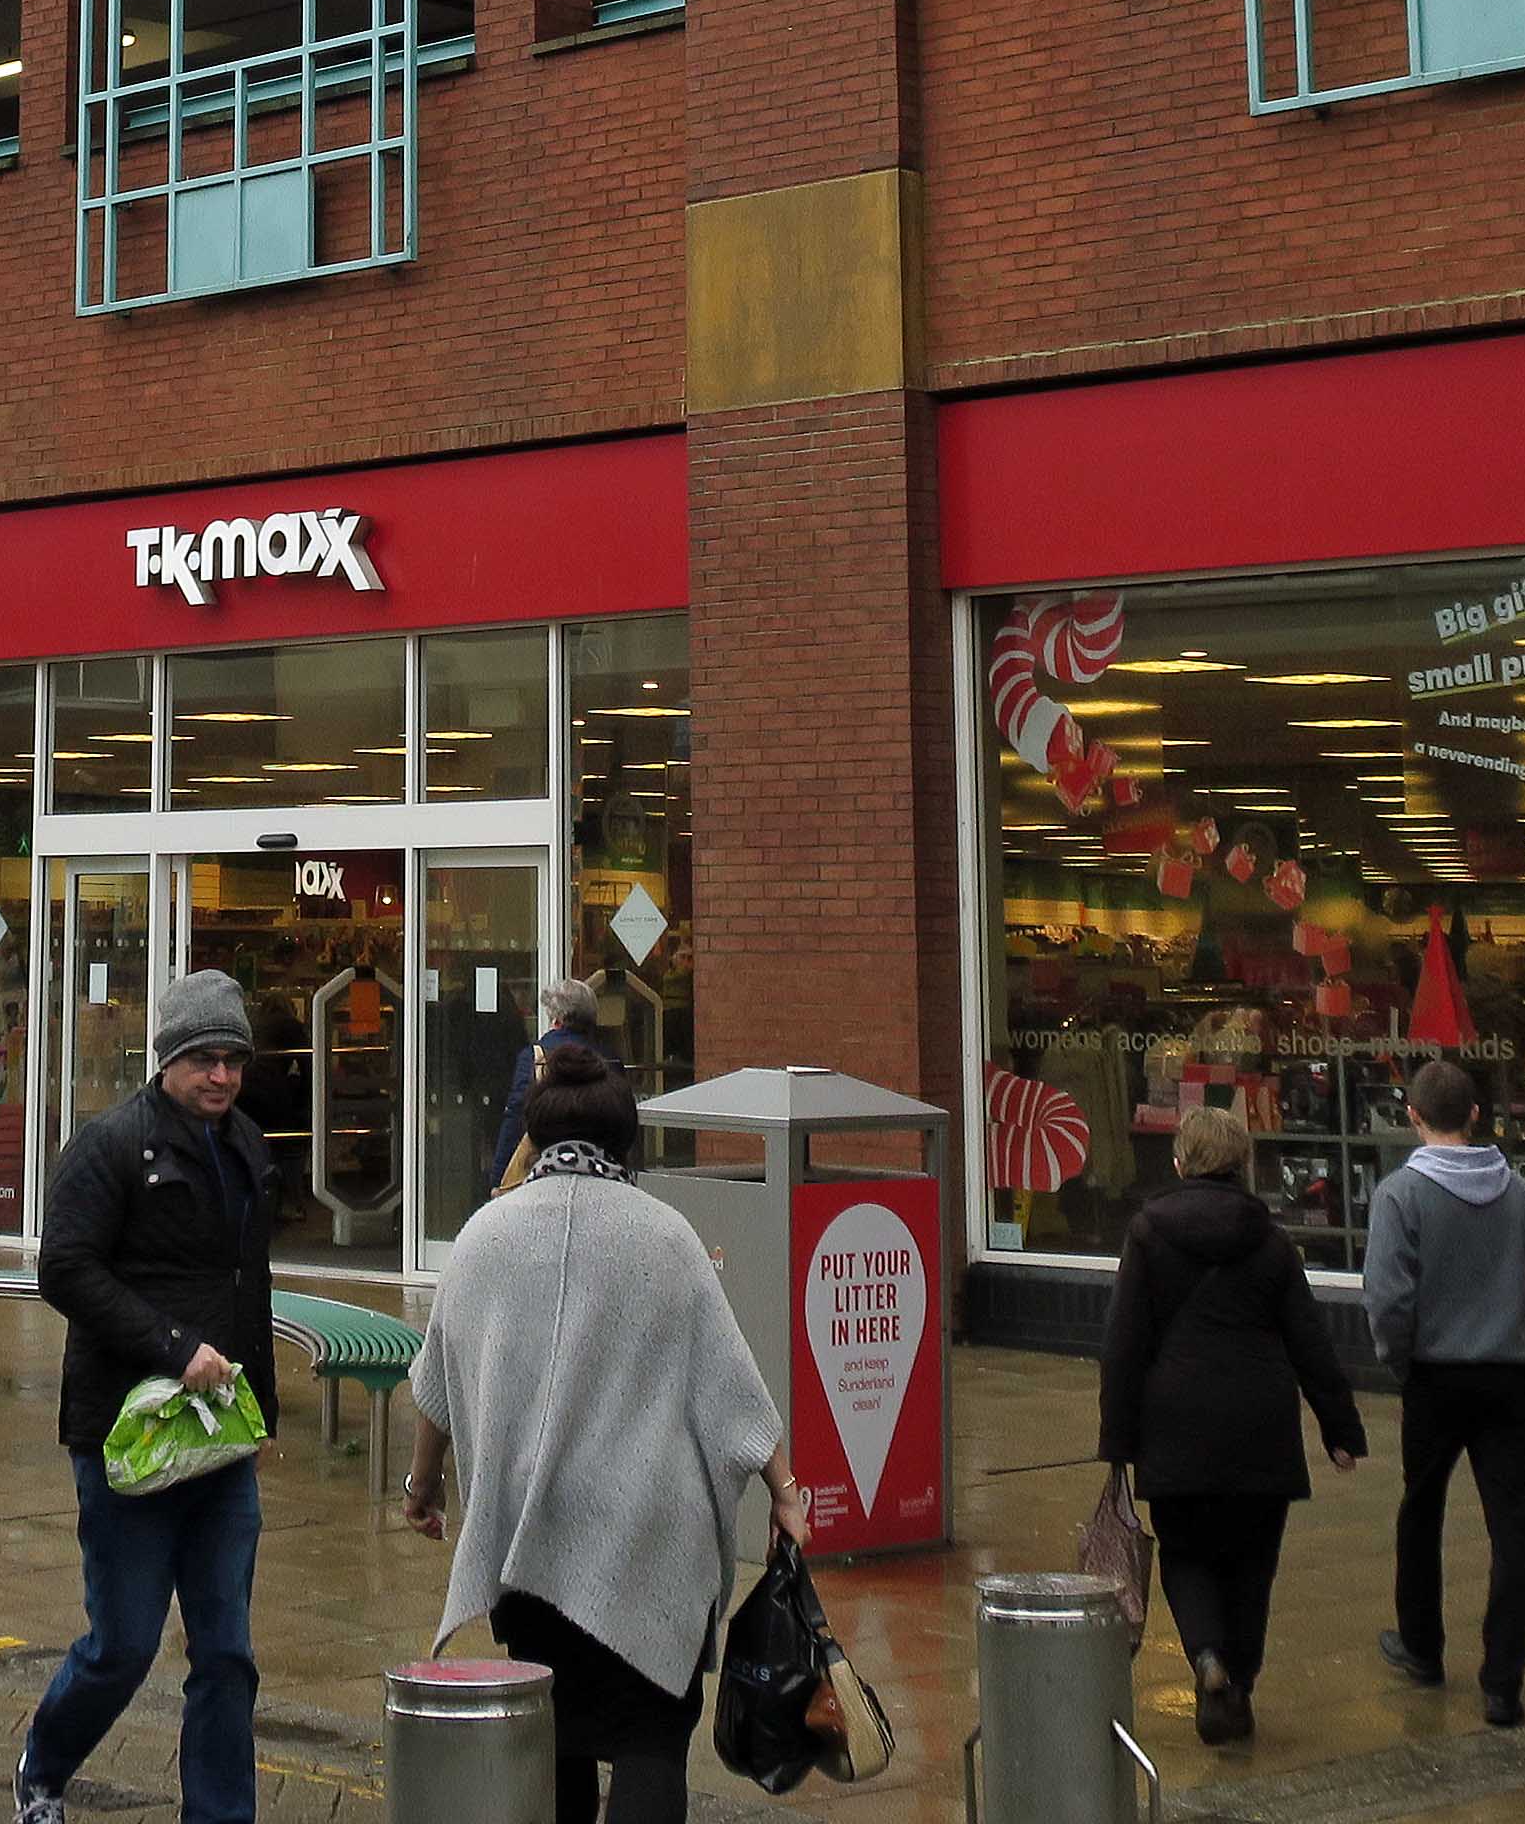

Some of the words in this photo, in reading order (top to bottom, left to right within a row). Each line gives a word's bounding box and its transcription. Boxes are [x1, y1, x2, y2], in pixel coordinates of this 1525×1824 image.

[1435, 600, 1489, 638] Big
[1408, 653, 1494, 693] small
[1438, 711, 1472, 727] And
[1414, 742, 1425, 754] a
[295, 860, 345, 901] axx
[1277, 1028, 1353, 1057] shoes
[1458, 1032, 1515, 1060] kids
[821, 1253, 856, 1281] PUT
[863, 1250, 911, 1278] YOUR
[835, 1284, 897, 1313] LITTER
[832, 1319, 849, 1347] IN
[856, 1315, 901, 1344] HERE
[843, 1360, 863, 1372] and
[864, 1357, 889, 1373] keep
[838, 1374, 895, 1393] Sunderland
